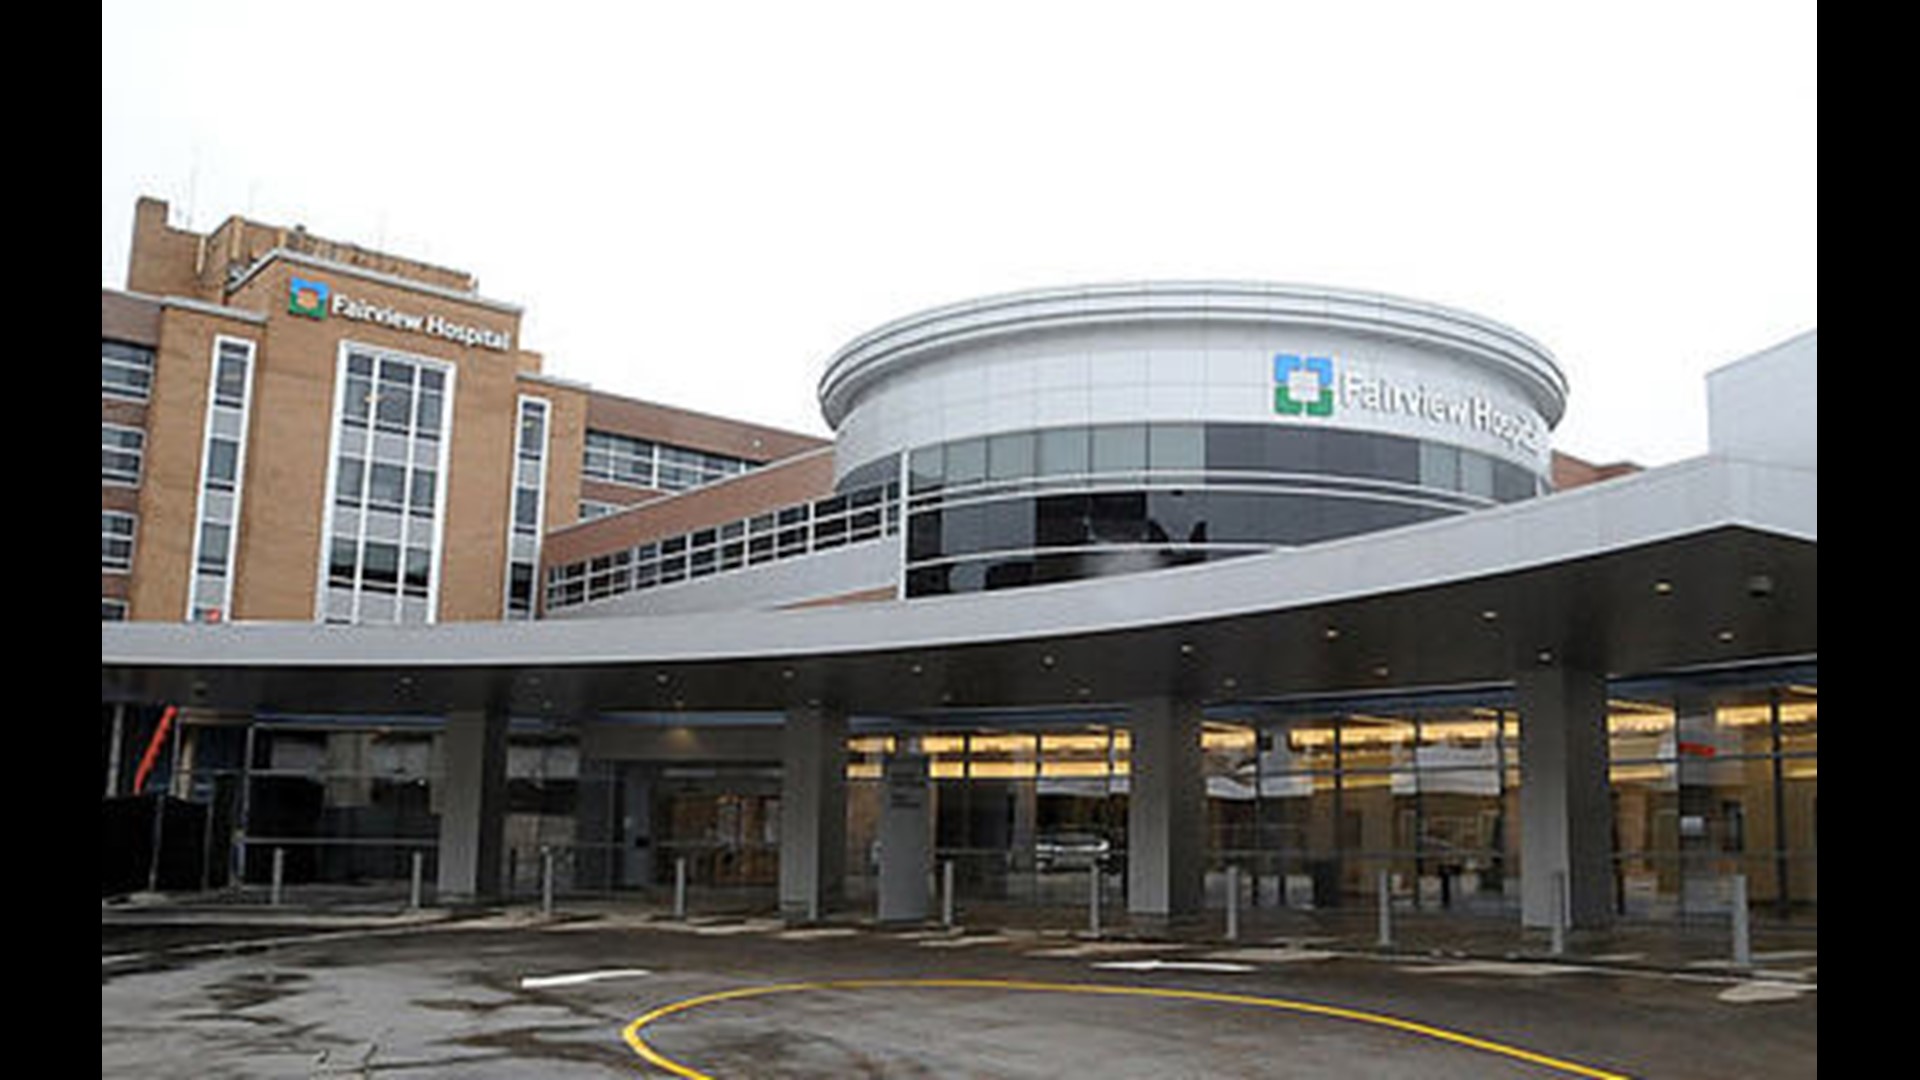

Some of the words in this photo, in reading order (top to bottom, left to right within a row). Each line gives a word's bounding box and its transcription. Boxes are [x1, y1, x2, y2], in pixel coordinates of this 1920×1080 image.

[332, 293, 421, 331] Fairview
[426, 315, 511, 351] Hospital
[1341, 372, 1470, 426] Fairview
[1471, 397, 1545, 459] Hospi
